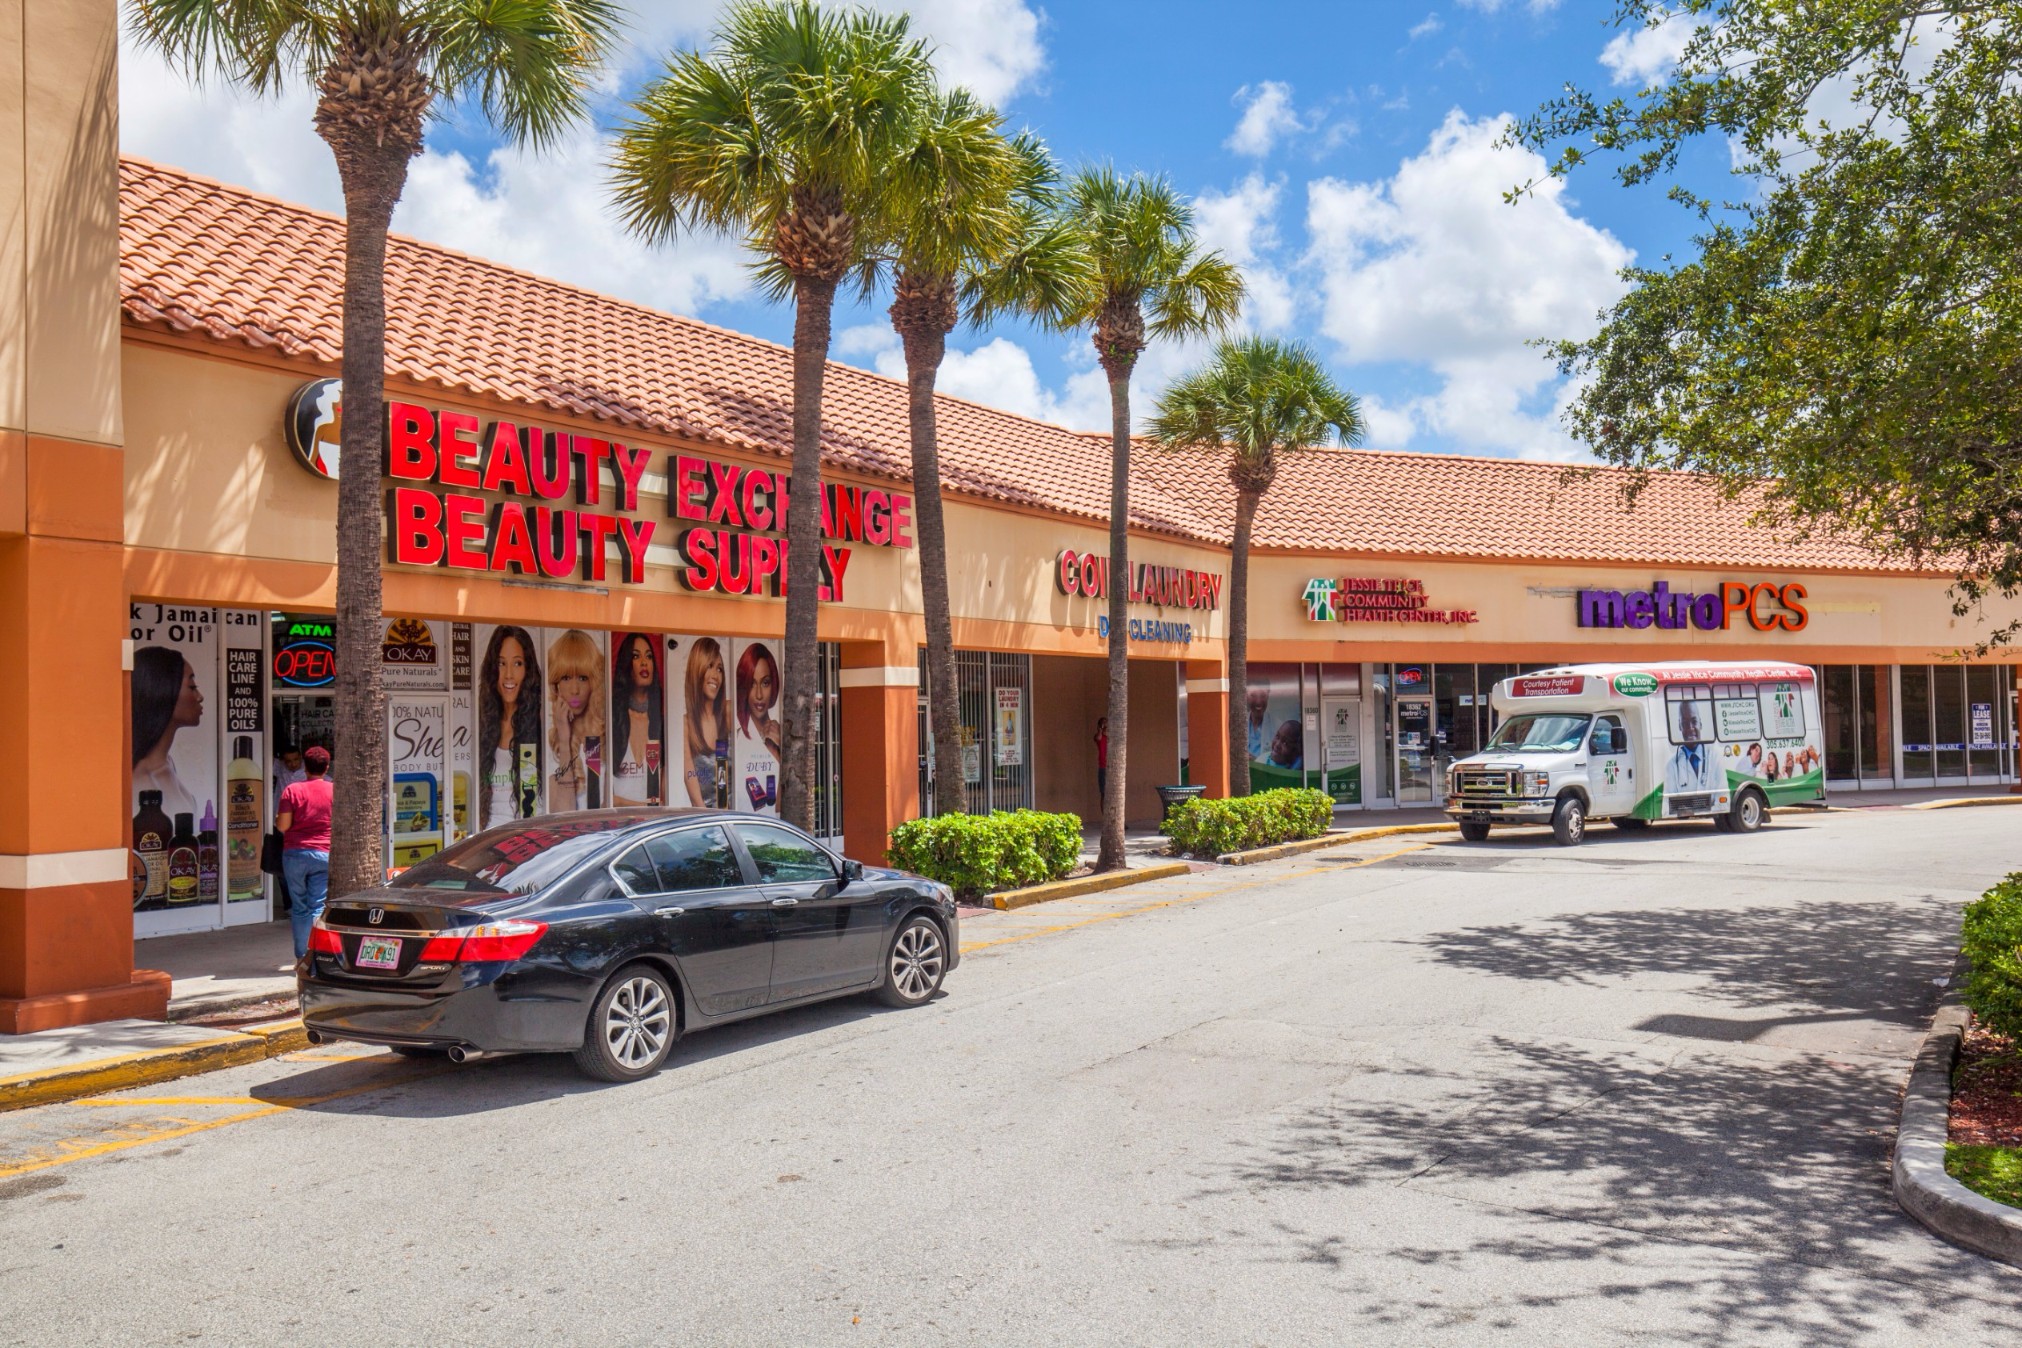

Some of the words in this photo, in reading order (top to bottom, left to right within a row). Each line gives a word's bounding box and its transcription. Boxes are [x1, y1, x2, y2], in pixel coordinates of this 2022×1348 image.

[387, 400, 652, 513] BEAUTY
[393, 486, 658, 584] BEAUTY
[685, 528, 852, 603] SUPY
[1057, 549, 1111, 599] COI
[1128, 560, 1222, 610] LAUNDRY
[1343, 578, 1382, 593] JESSIE
[1344, 594, 1430, 608] COMMUNITY
[1576, 581, 1809, 632] metroPCS
[1345, 610, 1395, 622] HEALTH
[1452, 610, 1479, 623] INC.
[289, 624, 332, 636] ATM
[1129, 618, 1192, 644] CLEANING
[229, 651, 256, 662] HAIR
[387, 647, 432, 661] OKAY
[228, 662, 257, 673] CARE
[273, 650, 337, 677] OPEN
[381, 667, 401, 676] Pure
[1707, 670, 1745, 680] Community
[231, 673, 255, 684] LINE
[1522, 680, 1551, 689] Courtesy
[1551, 678, 1574, 687] Patient
[234, 687, 252, 695] AND
[382, 681, 445, 690] kayPureNaturals.com
[1524, 687, 1569, 696] Transportation
[229, 698, 258, 708] 100%
[229, 709, 257, 719] PURE
[1973, 711, 1991, 719] LEASE
[231, 720, 256, 730] OILS
[393, 763, 421, 772] BODY
[228, 822, 258, 830] Conditioner
